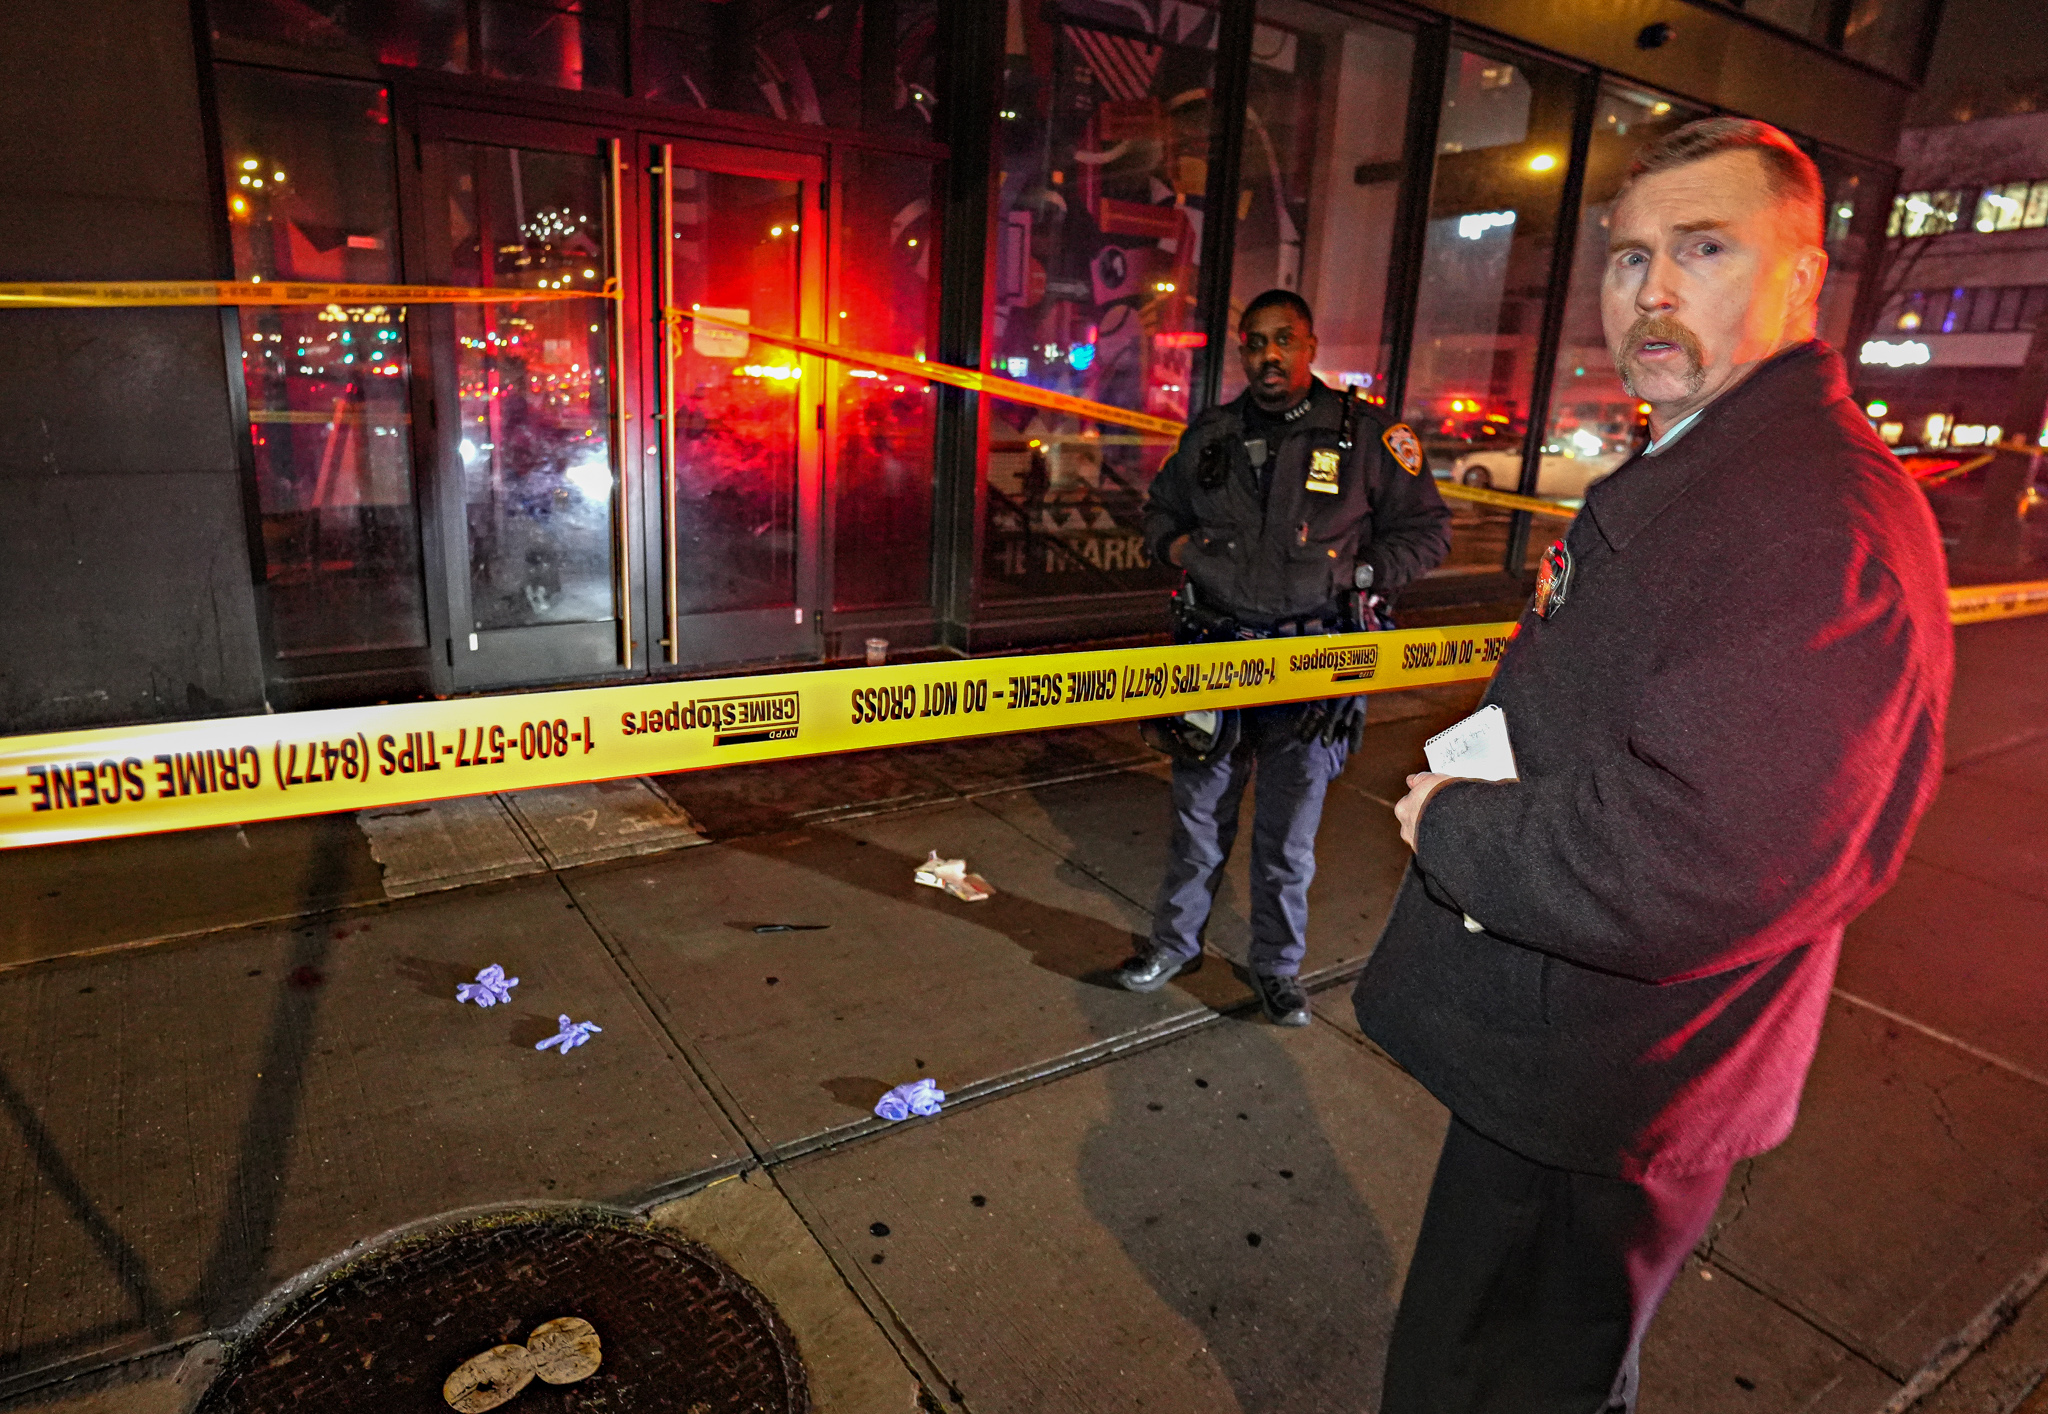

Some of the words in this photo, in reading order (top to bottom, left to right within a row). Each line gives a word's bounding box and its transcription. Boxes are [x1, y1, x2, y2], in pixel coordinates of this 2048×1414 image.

[1402, 641, 1436, 669] CROSS
[1436, 640, 1458, 666] NOT
[1459, 639, 1473, 665] DO
[1007, 672, 1062, 709] SCENE
[1065, 668, 1117, 703] CRIME
[1121, 663, 1168, 702] (8477)
[1171, 657, 1275, 694] 1-800-577-TIPS
[851, 684, 916, 724] CROSS
[920, 681, 957, 717] NOT
[963, 679, 987, 714] DO
[377, 716, 595, 777] 1-800-577-TIPS
[768, 728, 797, 739] NYPD
[154, 745, 261, 798] CRIME
[274, 732, 369, 791] (8477)
[26, 756, 146, 812] SCENE
